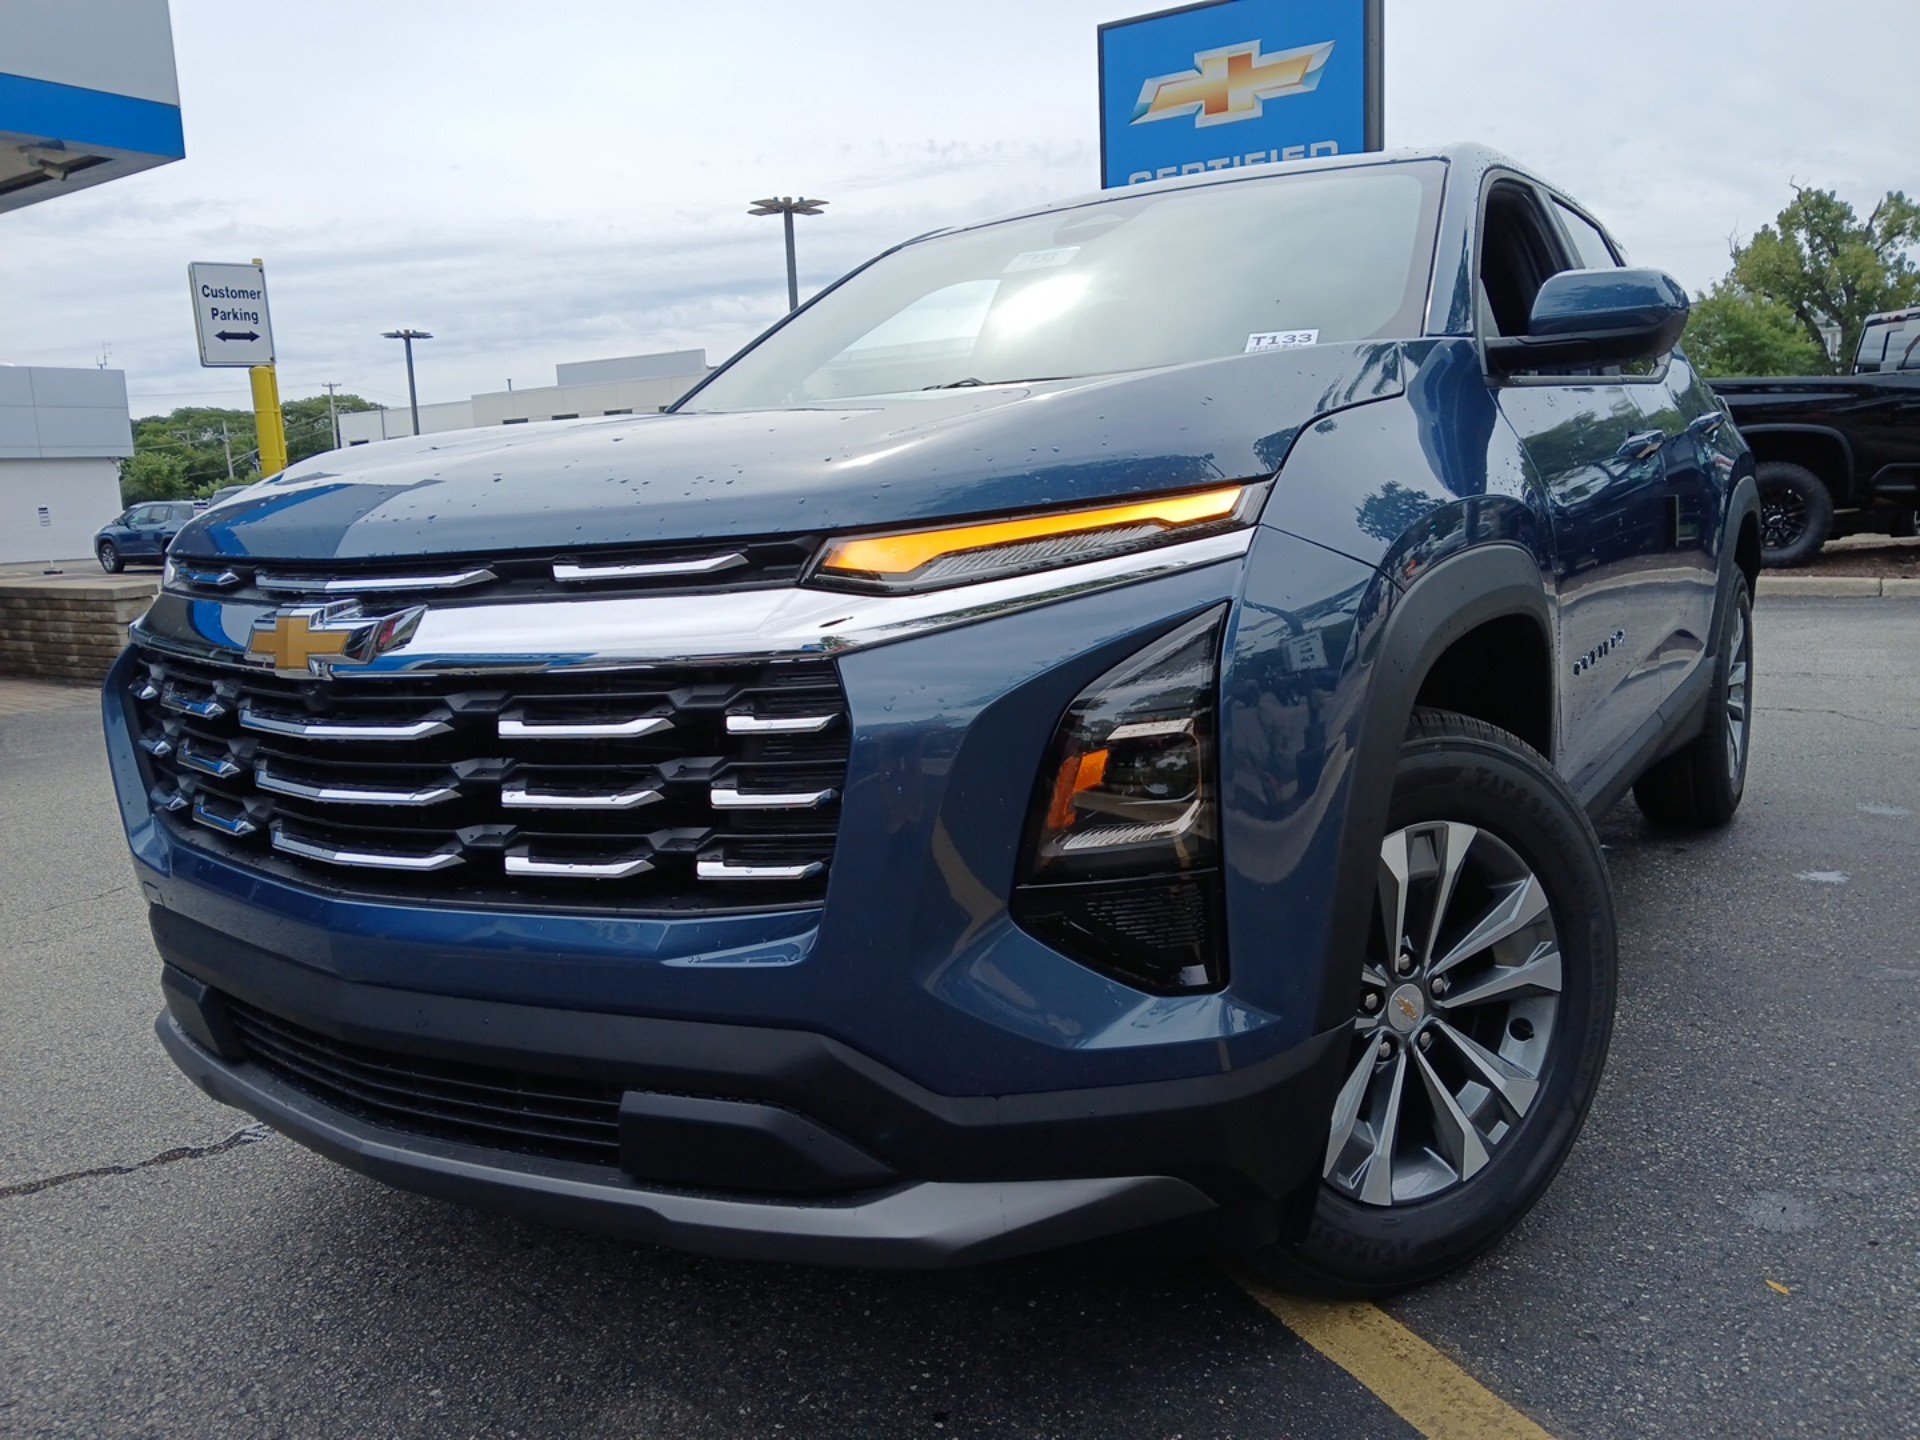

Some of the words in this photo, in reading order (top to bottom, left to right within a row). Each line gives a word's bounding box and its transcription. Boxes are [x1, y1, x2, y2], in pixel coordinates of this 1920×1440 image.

[201, 284, 262, 300] Customer
[210, 307, 259, 325] Parking
[1252, 332, 1313, 346] T133
